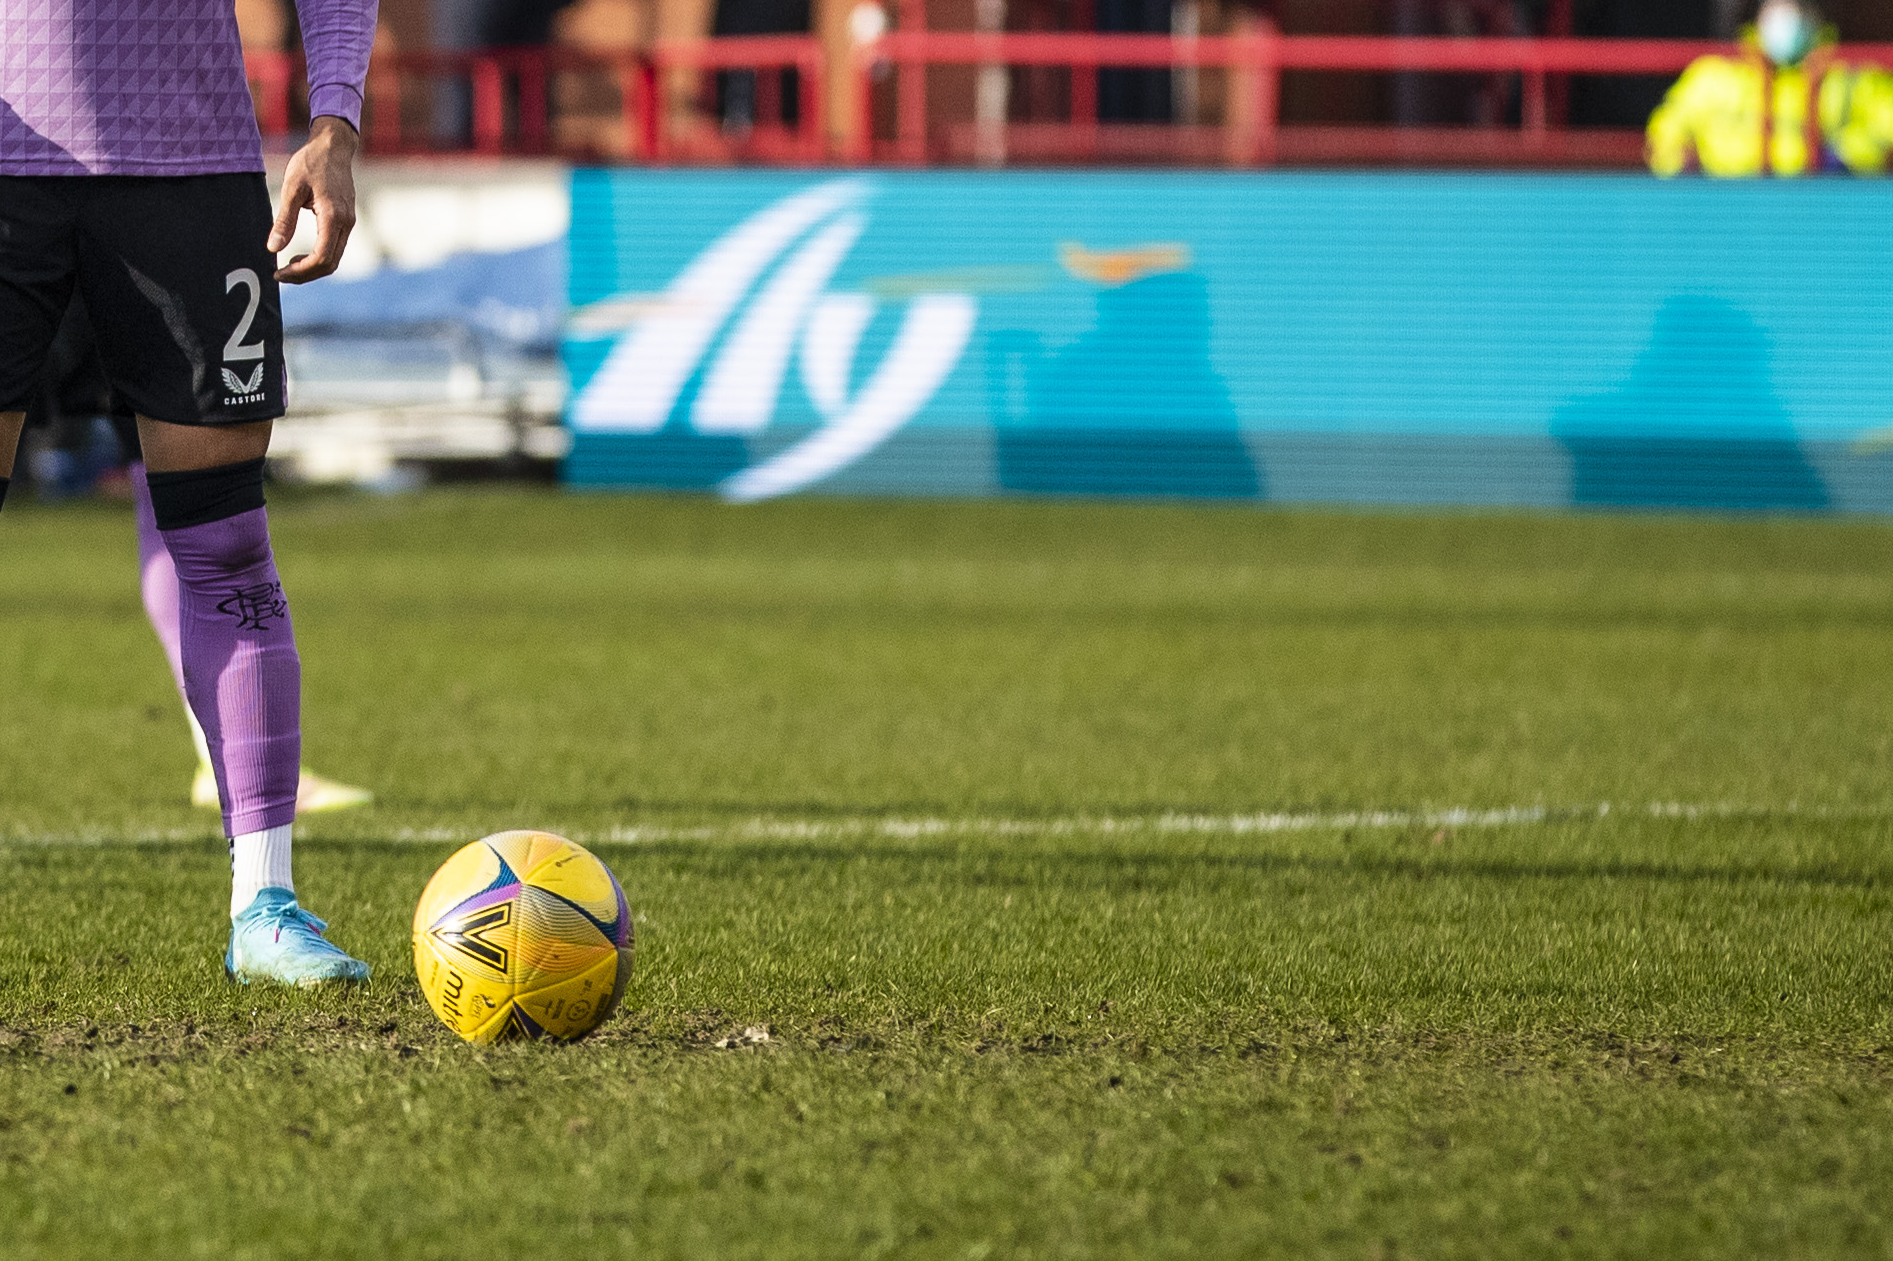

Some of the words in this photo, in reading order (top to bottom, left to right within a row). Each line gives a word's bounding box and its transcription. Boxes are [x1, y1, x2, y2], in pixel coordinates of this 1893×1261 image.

[222, 267, 265, 362] 2
[224, 392, 265, 406] CASTORE
[443, 970, 463, 1033] mitre
